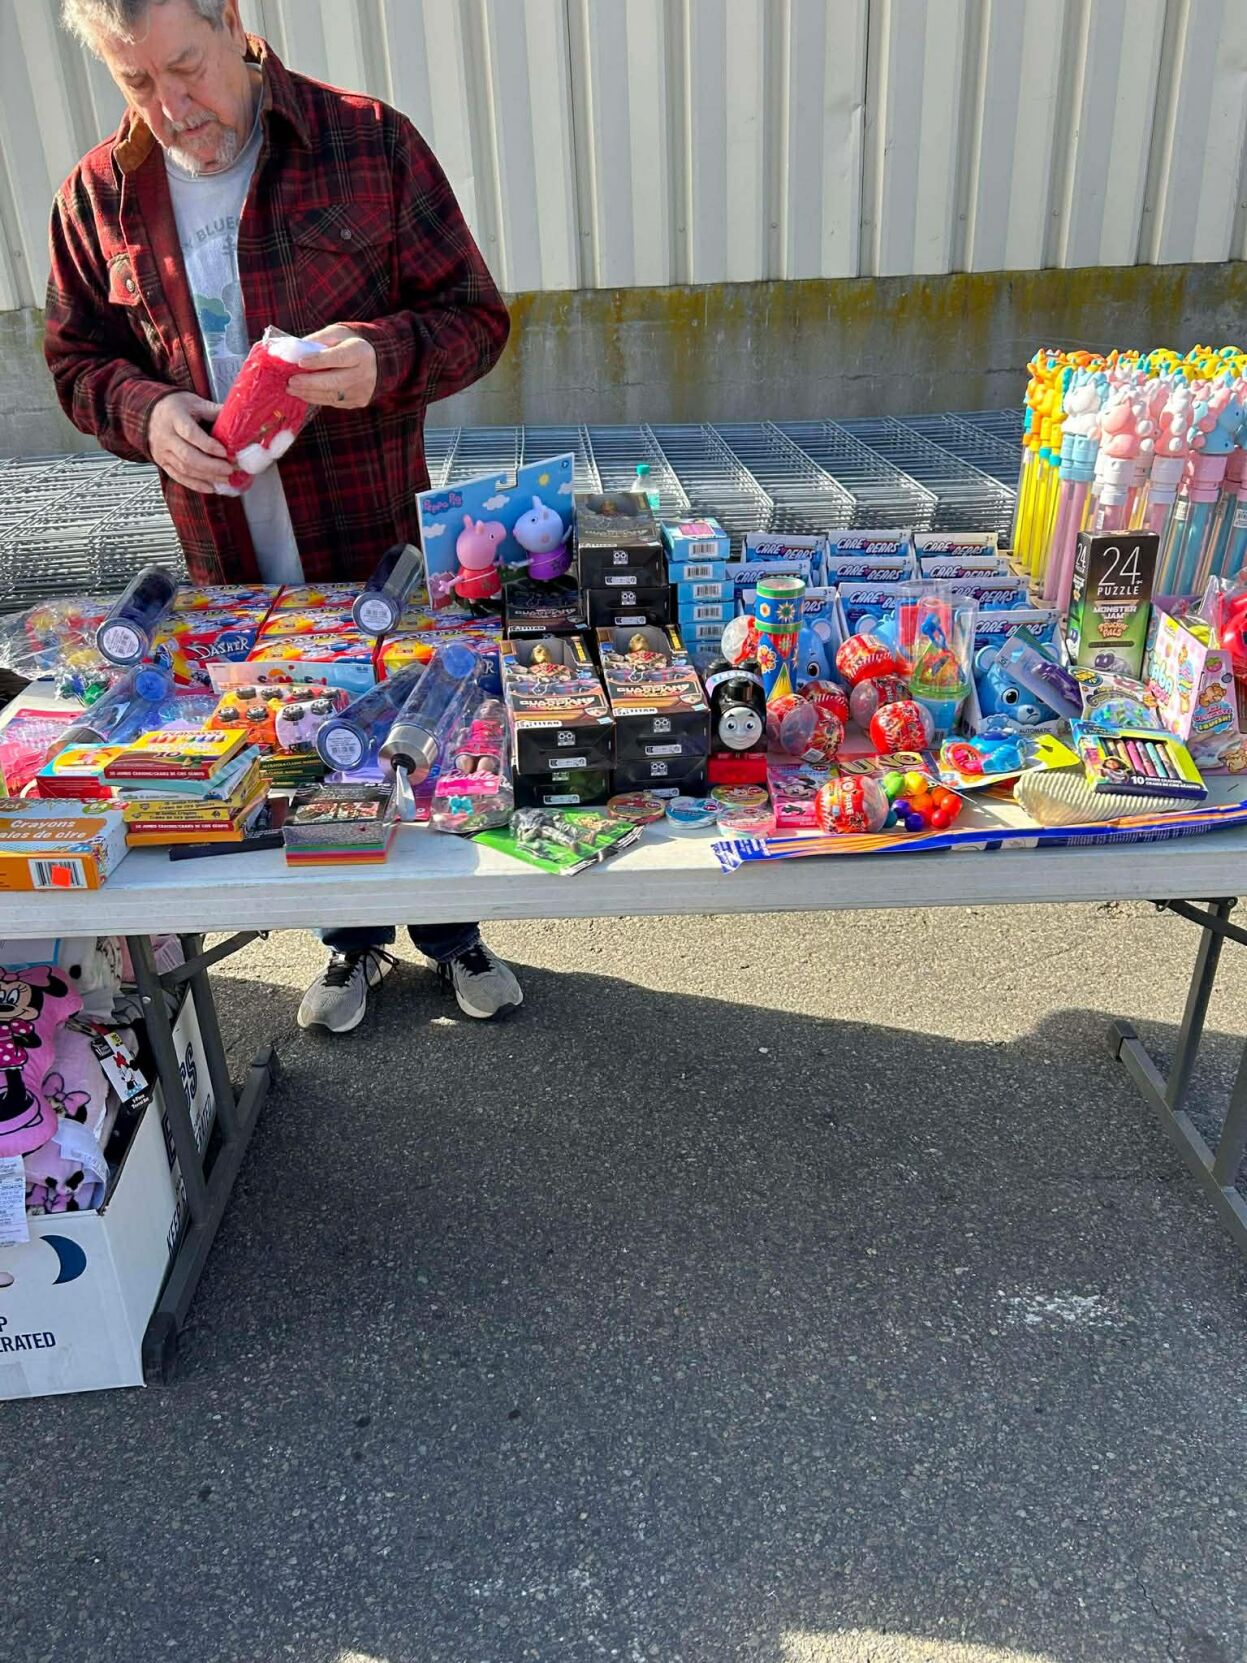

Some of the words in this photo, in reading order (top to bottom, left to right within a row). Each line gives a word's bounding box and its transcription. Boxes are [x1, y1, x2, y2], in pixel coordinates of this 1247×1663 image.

[196, 216, 239, 242] BLUE
[423, 500, 449, 513] Peppa
[449, 493, 463, 506] Pig
[755, 543, 785, 555] CARE
[783, 549, 816, 560] BEARS
[837, 539, 867, 550] CARE
[866, 543, 901, 554] BEARS
[923, 541, 952, 553] CARE
[951, 546, 986, 556] BEARS
[836, 565, 868, 577] CARE
[866, 570, 903, 581] BEARS
[930, 566, 961, 577] CARE
[1098, 546, 1141, 586] 24
[734, 571, 765, 584] CARE
[850, 592, 883, 604] CARE
[951, 587, 980, 600] CARE
[979, 590, 1018, 602] BEARS
[1097, 586, 1140, 596] PUZZLE
[804, 600, 825, 612] ARS
[1093, 605, 1137, 613] MONSTER
[975, 621, 1007, 633] CARE
[1006, 624, 1047, 638] BRS
[187, 636, 249, 660] DASHER
[839, 751, 924, 774] UNO
[1130, 775, 1145, 785] 10
[10, 820, 76, 829] Crayons
[0, 831, 30, 839] aies
[33, 830, 52, 839] de
[56, 830, 86, 839] cire
[0, 1331, 56, 1353] RATED
